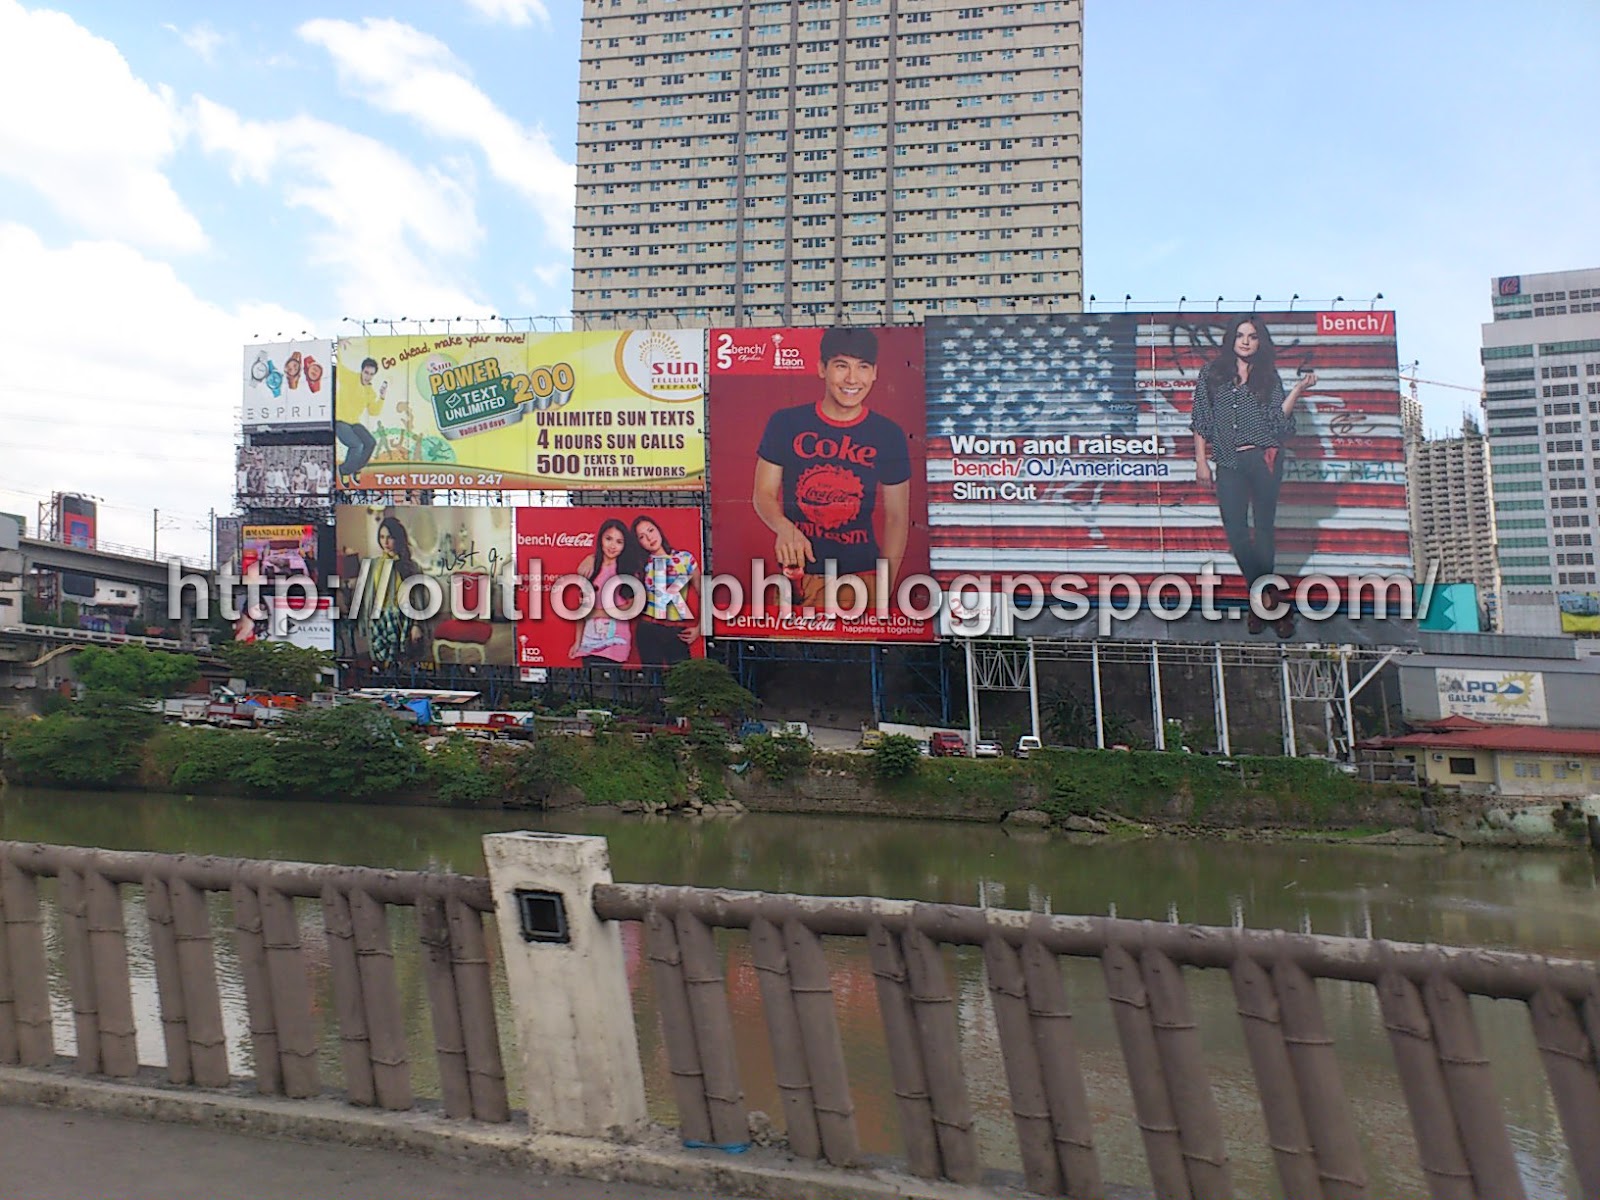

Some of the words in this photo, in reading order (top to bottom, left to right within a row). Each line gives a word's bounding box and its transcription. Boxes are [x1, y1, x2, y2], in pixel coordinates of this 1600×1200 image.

[1322, 314, 1388, 333] bench/
[381, 356, 397, 369] Go
[434, 335, 463, 350] make
[466, 334, 491, 348] your
[495, 333, 526, 344] move!
[731, 343, 767, 355] bench/
[781, 348, 800, 358] 100
[652, 362, 699, 375] sun
[781, 358, 804, 367] taon
[429, 357, 501, 395] POWER
[461, 385, 498, 402] TEXT
[247, 405, 327, 420] ESPRIT
[445, 397, 505, 421] UNLIMITED
[536, 411, 612, 426] UNLIMITED
[617, 411, 646, 426] SUN
[650, 410, 695, 426] TEXTS
[459, 426, 478, 437] Valid
[489, 418, 506, 430] days
[537, 429, 549, 449] 4
[554, 434, 603, 449] HOURS
[607, 434, 636, 449] SUN
[641, 434, 685, 449] CALLS
[950, 435, 1017, 454] Worn
[1022, 435, 1071, 454] and
[1078, 434, 1166, 454] raised.
[793, 431, 878, 468] Coke
[537, 454, 580, 474] 500
[584, 454, 617, 465] TEXTS
[620, 454, 634, 465] TO
[584, 466, 619, 477] OTHER
[623, 466, 686, 477] NETWORKS
[953, 458, 1022, 477] bench/
[1026, 459, 1055, 477] OJ
[1059, 459, 1169, 477] Americana
[375, 474, 407, 486] Text
[409, 474, 455, 486] TU200
[458, 474, 474, 486] to
[477, 474, 504, 486] 247
[953, 482, 997, 500] Slim
[1000, 482, 1037, 500] Cut
[517, 533, 557, 547] bench/
[436, 541, 480, 578] just
[842, 613, 925, 627] collections
[842, 626, 886, 634] happiness
[887, 627, 925, 635] together
[1448, 694, 1486, 703] GALFAN
